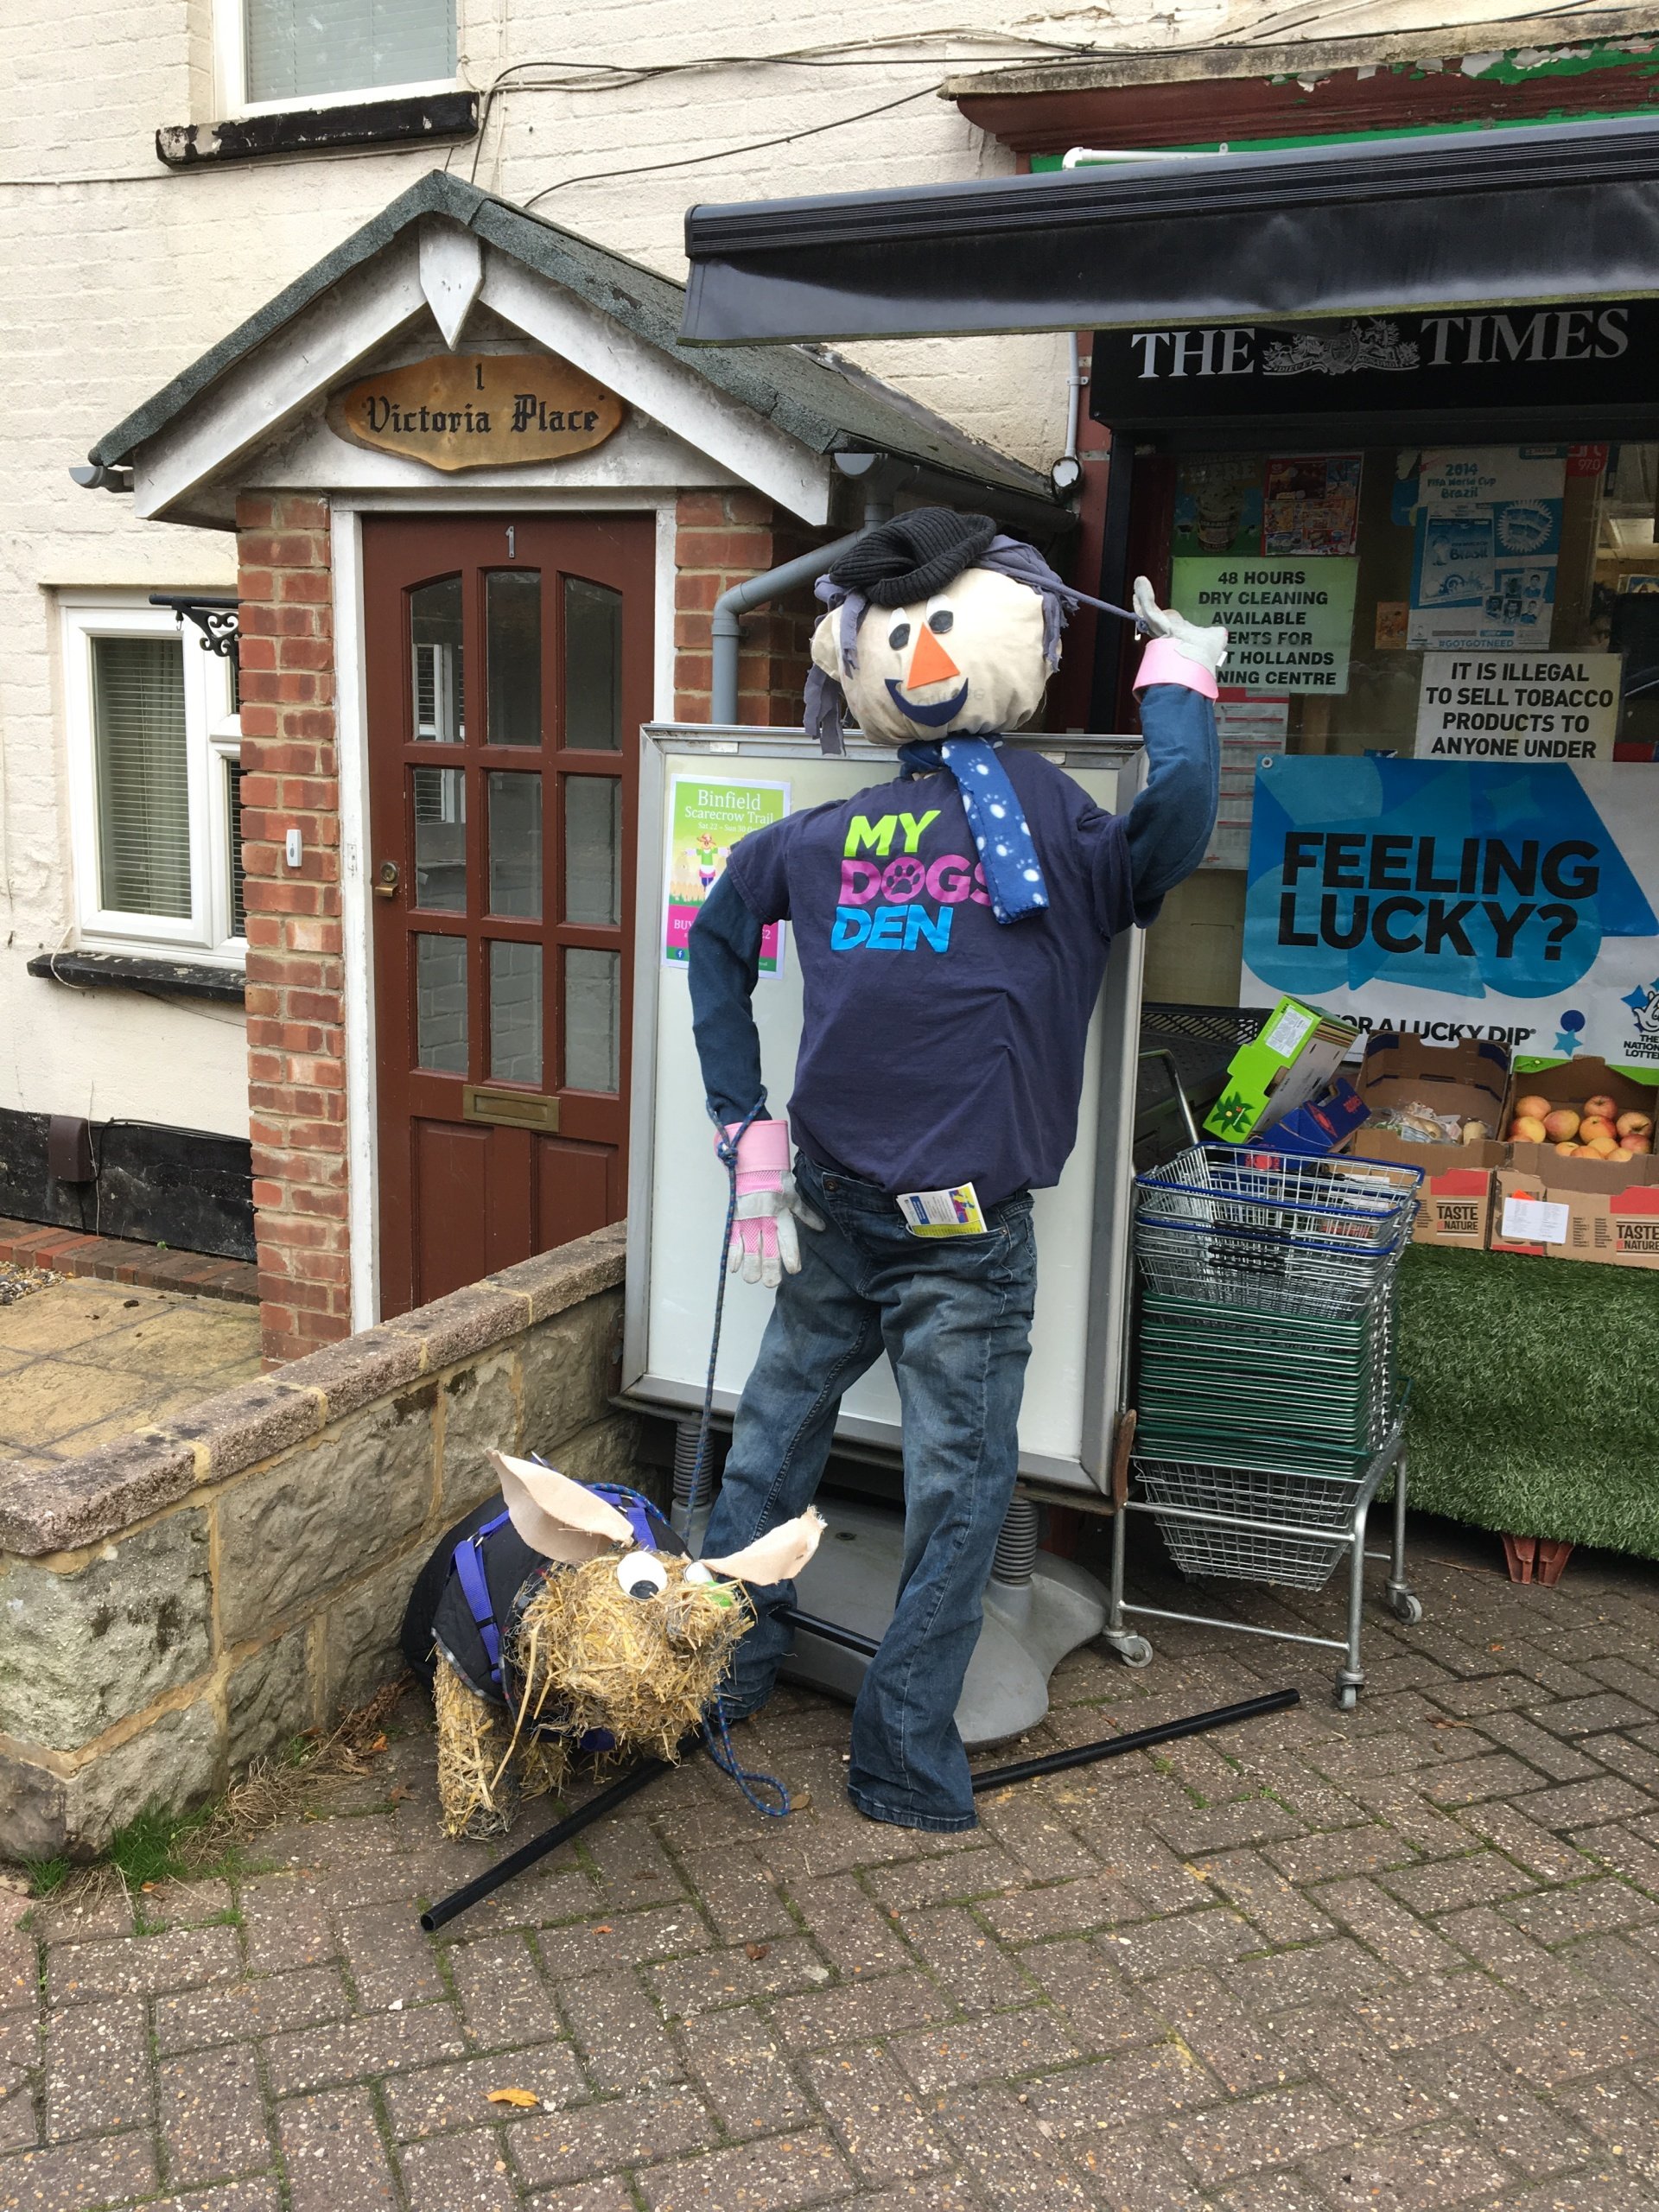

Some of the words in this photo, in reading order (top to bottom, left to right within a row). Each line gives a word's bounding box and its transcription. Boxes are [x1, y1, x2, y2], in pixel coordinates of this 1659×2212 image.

[1131, 327, 1255, 378] THE
[1421, 308, 1629, 365] TIMES
[365, 396, 492, 433] Victoria
[510, 394, 599, 433] Place
[1446, 463, 1478, 475] 2014
[1478, 476, 1496, 486] Cup
[1440, 486, 1478, 499] Brazil
[505, 525, 515, 559] 1
[1217, 571, 1238, 585] 48
[1243, 571, 1306, 585] HOURS
[1198, 591, 1233, 605] DRY
[1237, 591, 1328, 605] CLEANING
[1211, 612, 1306, 625] AVAILABLE
[1227, 632, 1272, 645] ENTS
[1277, 632, 1313, 645] FOR
[1439, 639, 1515, 648] #GOTGOTNEED
[1240, 652, 1334, 665] HOLLANDS
[1217, 671, 1260, 684] NING
[1265, 671, 1337, 685] CENTRE
[1451, 662, 1471, 680] IT
[1477, 662, 1497, 681] IS
[1502, 663, 1590, 682] ILLEGAL
[1426, 687, 1452, 704] TO
[1457, 687, 1510, 706] SELL
[1514, 688, 1614, 708] TOBACCO
[1442, 712, 1554, 732] PRODUCTS
[1560, 715, 1590, 733] TO
[1431, 736, 1519, 756] ANYONE
[1524, 739, 1597, 759] UNDER
[697, 789, 761, 810] Binfield
[684, 806, 745, 823] Scarecrow
[747, 811, 773, 824] Trail
[843, 810, 942, 857] MY
[1282, 831, 1600, 900] FEELING
[830, 904, 954, 953] DEN
[1278, 892, 1579, 961] LUCKY?
[1338, 1014, 1373, 1034] OR
[1378, 1018, 1393, 1032] A
[1639, 1034, 1659, 1044] THE
[1436, 1205, 1478, 1220] TASTE
[1444, 1220, 1478, 1230] NATURE
[1616, 1224, 1659, 1240] TASTE
[1624, 1240, 1659, 1250] NATURE
